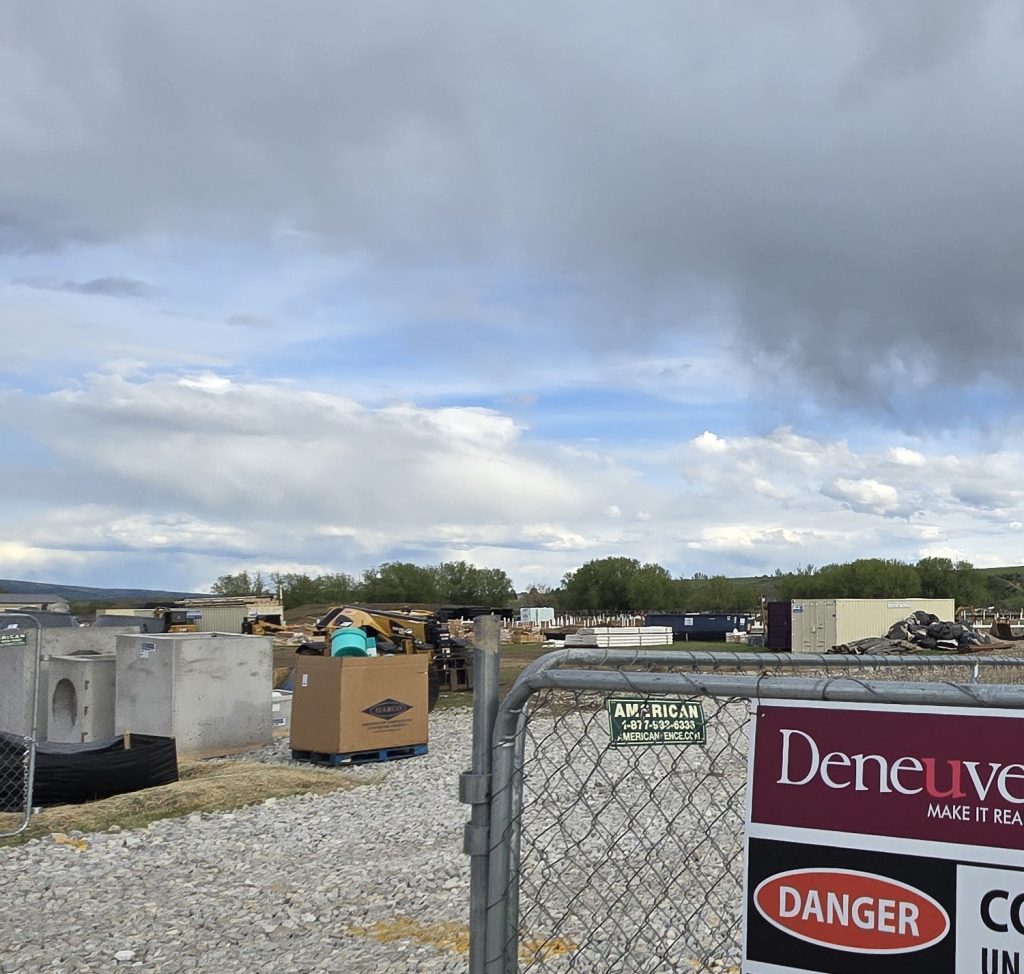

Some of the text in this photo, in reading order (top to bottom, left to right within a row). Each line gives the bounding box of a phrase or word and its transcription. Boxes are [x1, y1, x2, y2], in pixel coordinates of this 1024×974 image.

[927, 803, 970, 821] MAKE
[976, 807, 989, 822] IT
[779, 886, 919, 937] DANGER
